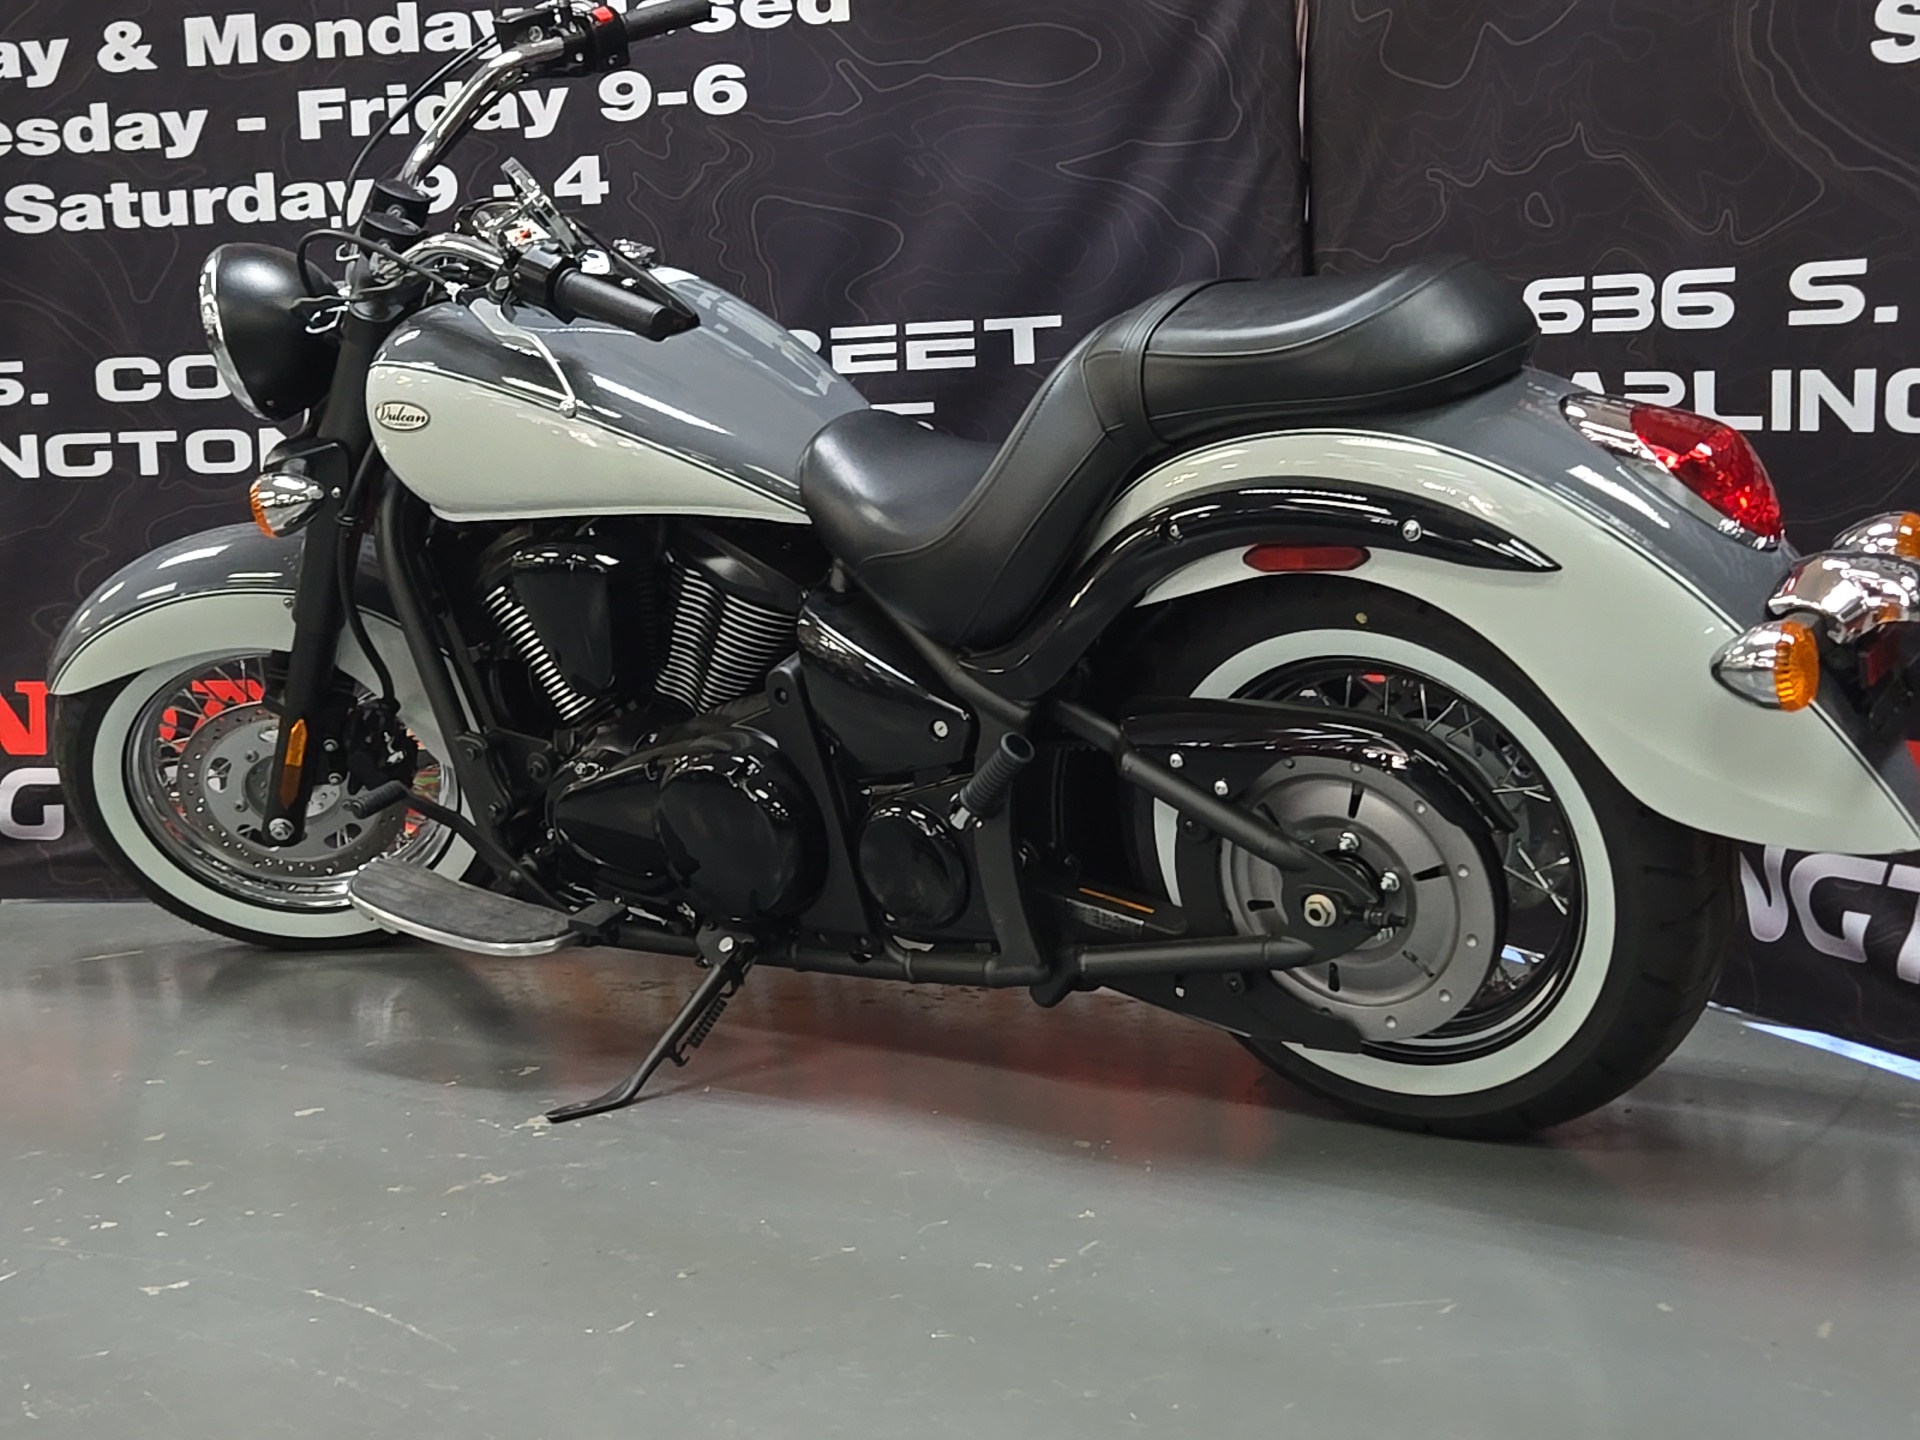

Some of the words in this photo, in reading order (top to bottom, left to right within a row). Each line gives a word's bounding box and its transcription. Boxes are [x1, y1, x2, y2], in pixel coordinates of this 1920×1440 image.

[97, 21, 158, 73] &
[0, 102, 208, 159] sday
[236, 117, 266, 131] -
[599, 63, 748, 122] 9-6
[3, 172, 375, 234] Saturday
[554, 155, 610, 205] 4
[1523, 267, 1736, 334] 636
[1788, 258, 1899, 326] S.
[376, 402, 426, 423] Vulcan
